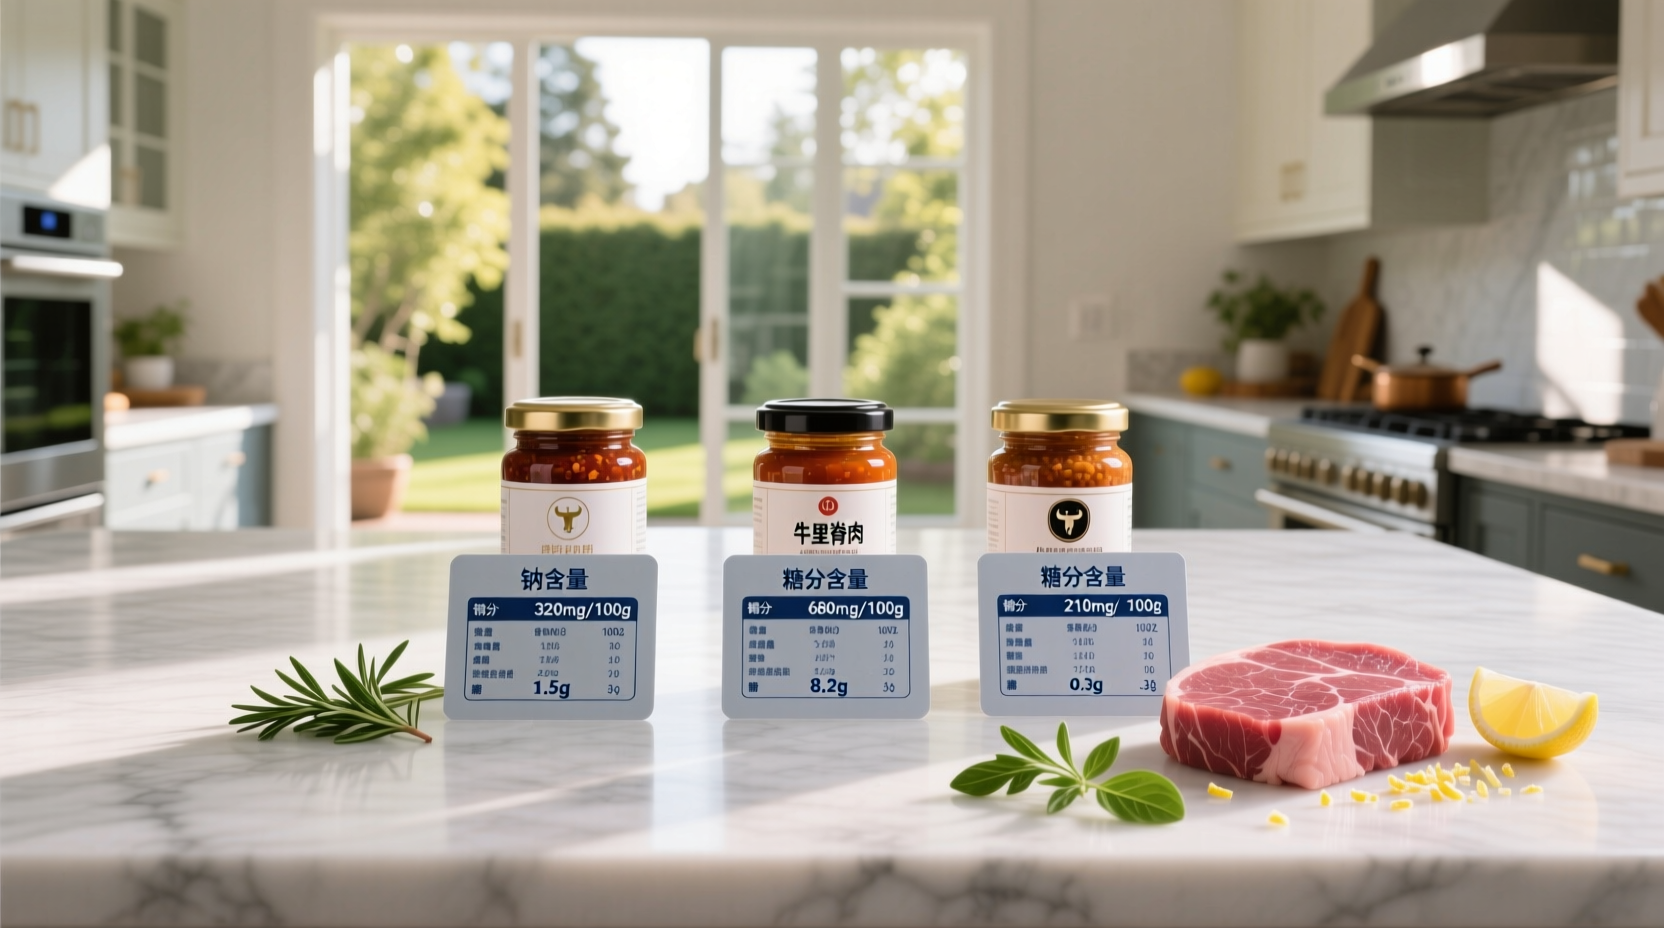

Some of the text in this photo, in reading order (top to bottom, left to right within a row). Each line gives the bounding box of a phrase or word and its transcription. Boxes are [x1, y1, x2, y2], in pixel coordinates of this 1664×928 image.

[793, 521, 864, 546] 牛里脊肉
[520, 567, 589, 591] 钠含量
[782, 567, 869, 590] 糖分含量
[1040, 565, 1126, 588] 糖分含量
[534, 602, 632, 620] 320mg/100g
[807, 600, 904, 619] 680mg/100g
[533, 679, 571, 699] 1.5g
[810, 677, 848, 697] 8.2g
[1069, 677, 1103, 694] 0.3g
